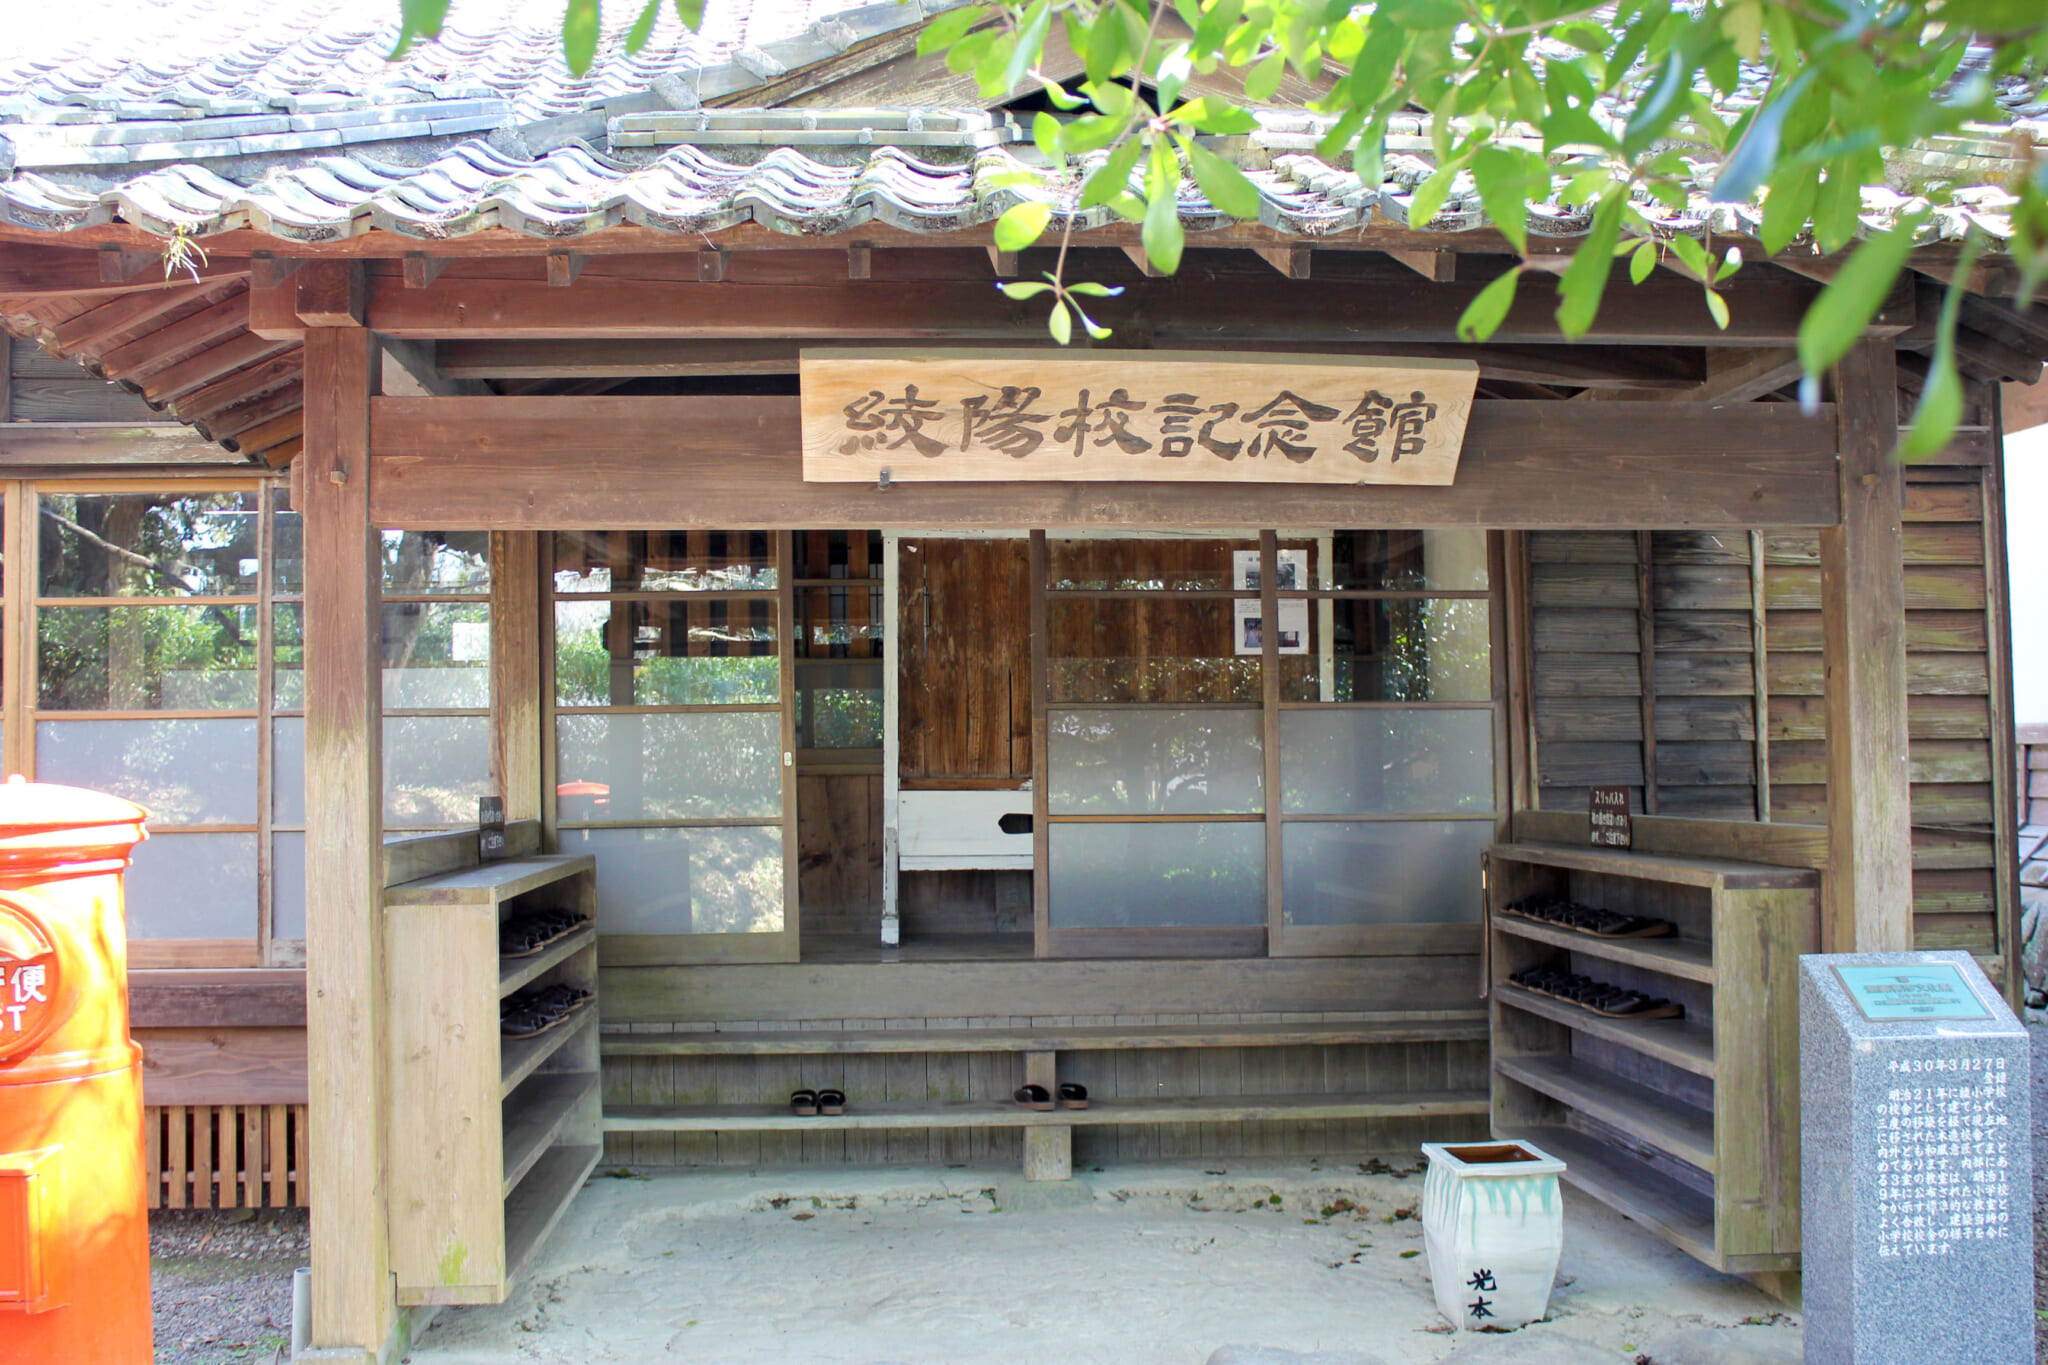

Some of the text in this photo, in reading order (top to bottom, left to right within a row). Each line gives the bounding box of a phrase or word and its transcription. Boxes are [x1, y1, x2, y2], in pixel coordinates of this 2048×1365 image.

[0, 964, 48, 1003] 便
[1887, 1057, 2006, 1073] 平成30年3月27日
